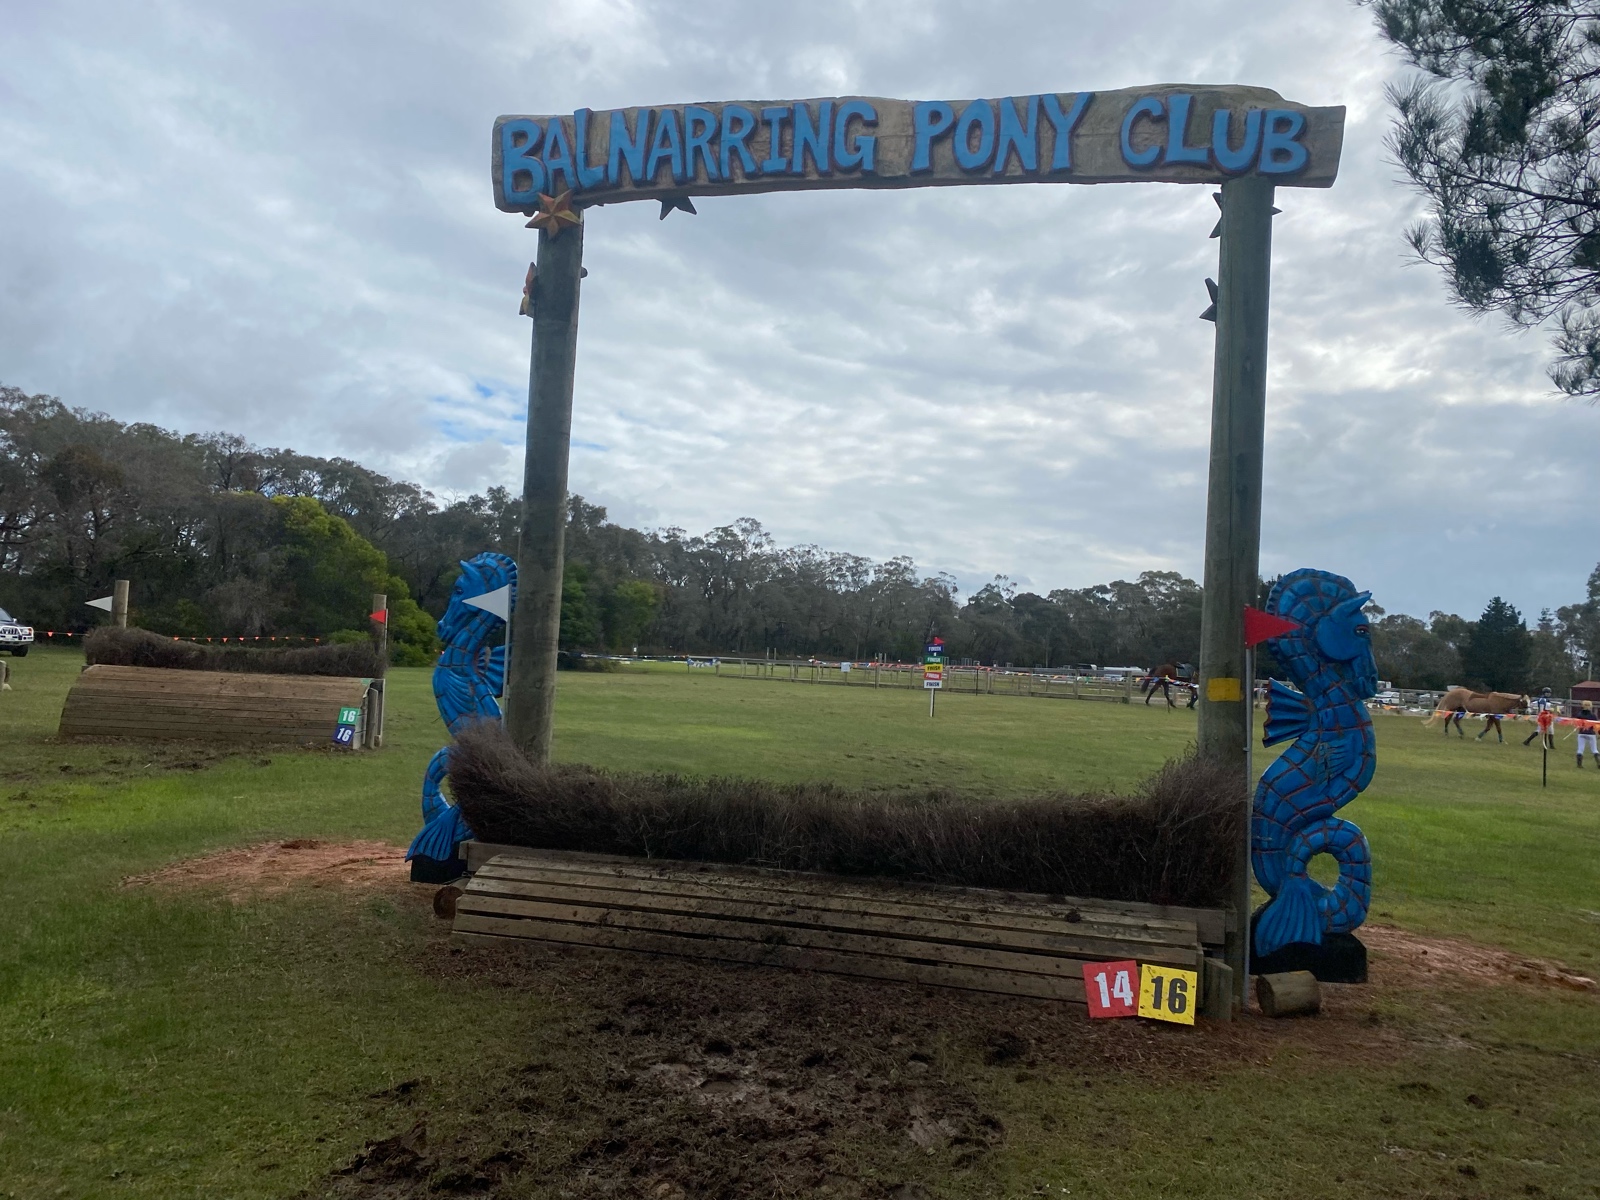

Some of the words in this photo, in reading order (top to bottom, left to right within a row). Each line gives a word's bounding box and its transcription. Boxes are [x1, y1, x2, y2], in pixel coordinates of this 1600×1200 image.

[502, 100, 878, 203] BALNARRING
[910, 92, 1095, 175] PONY
[1120, 93, 1310, 175] CLUB
[337, 727, 352, 742] 16
[342, 710, 357, 722] 16
[1094, 970, 1134, 1008] 14
[1151, 975, 1188, 1014] 16
